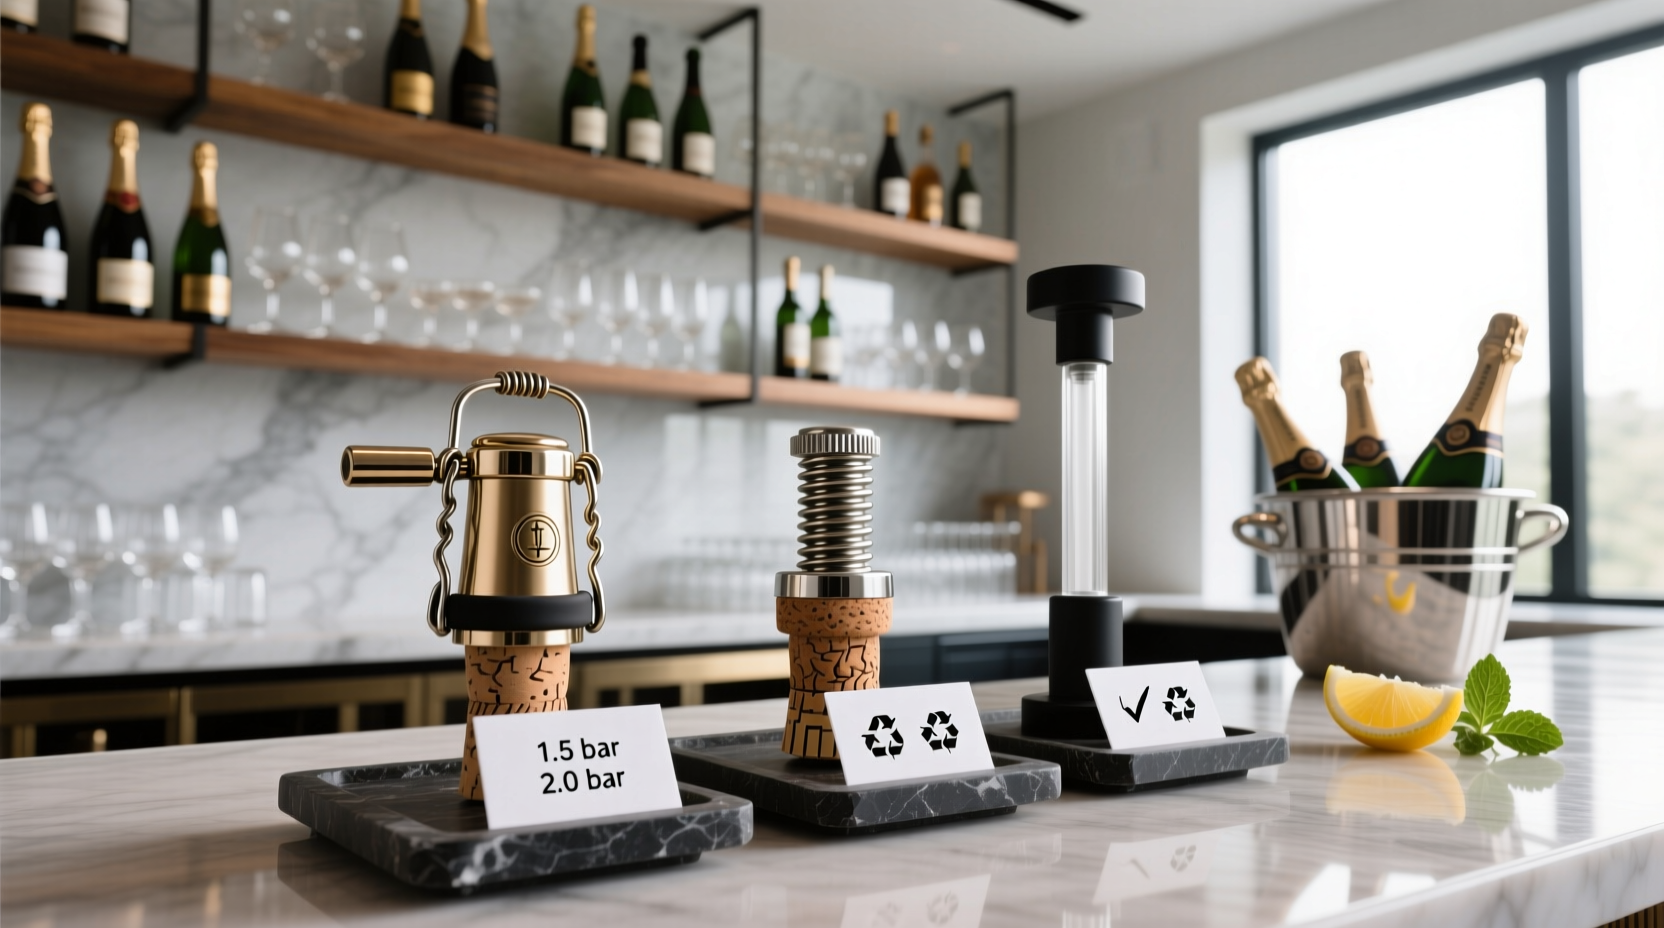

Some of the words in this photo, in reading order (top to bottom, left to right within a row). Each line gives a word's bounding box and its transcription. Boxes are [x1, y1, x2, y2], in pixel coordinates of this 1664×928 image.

[537, 740, 574, 762] 1.5
[580, 738, 620, 760] bar
[540, 770, 579, 794] 2.0
[585, 768, 625, 790] bar
